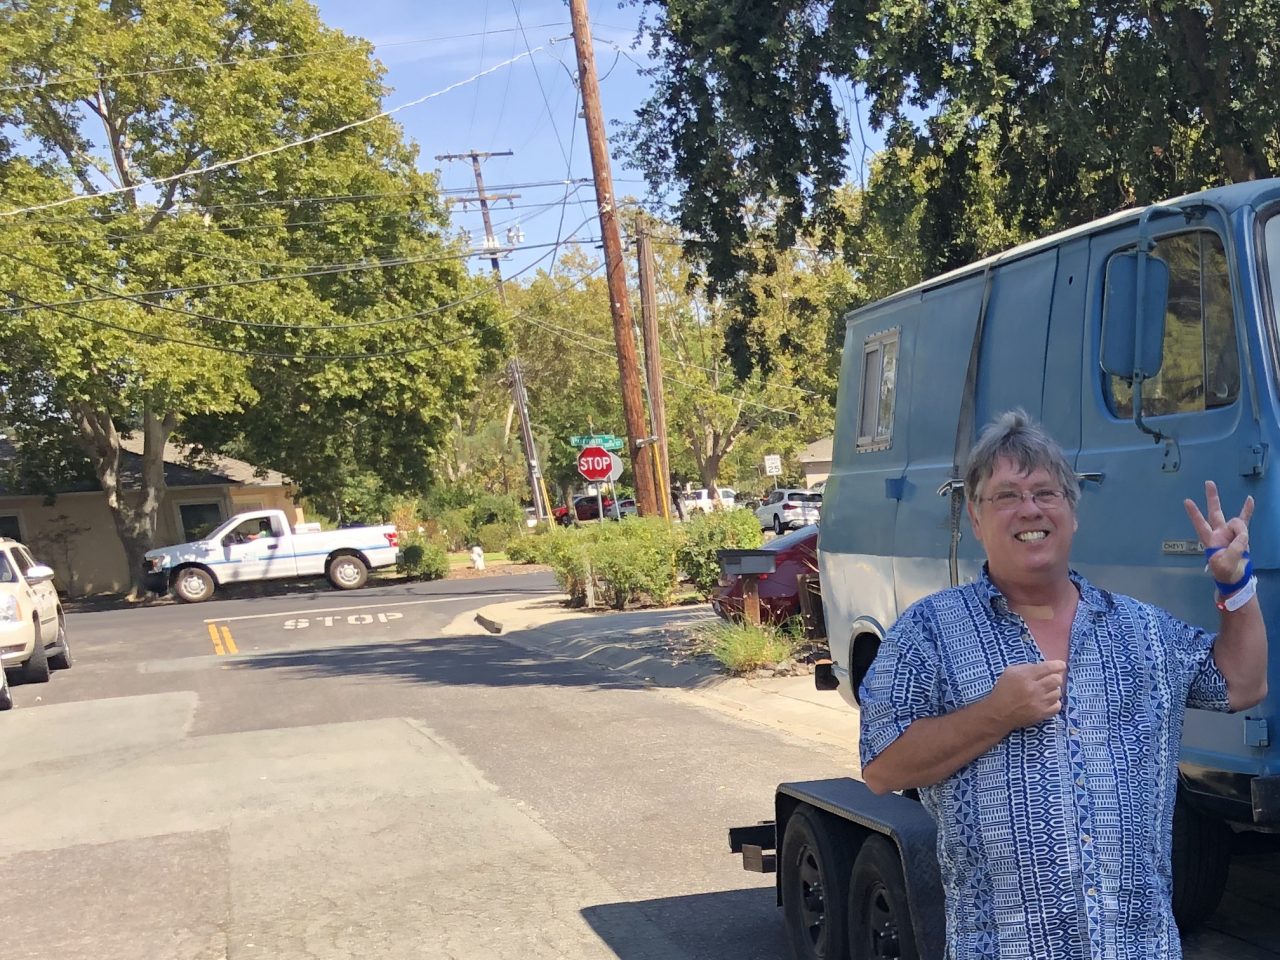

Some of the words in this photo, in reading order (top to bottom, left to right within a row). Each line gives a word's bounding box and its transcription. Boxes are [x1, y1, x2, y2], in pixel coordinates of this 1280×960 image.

[580, 457, 611, 471] STOP
[768, 465, 780, 473] 25
[283, 612, 404, 630] STOP
